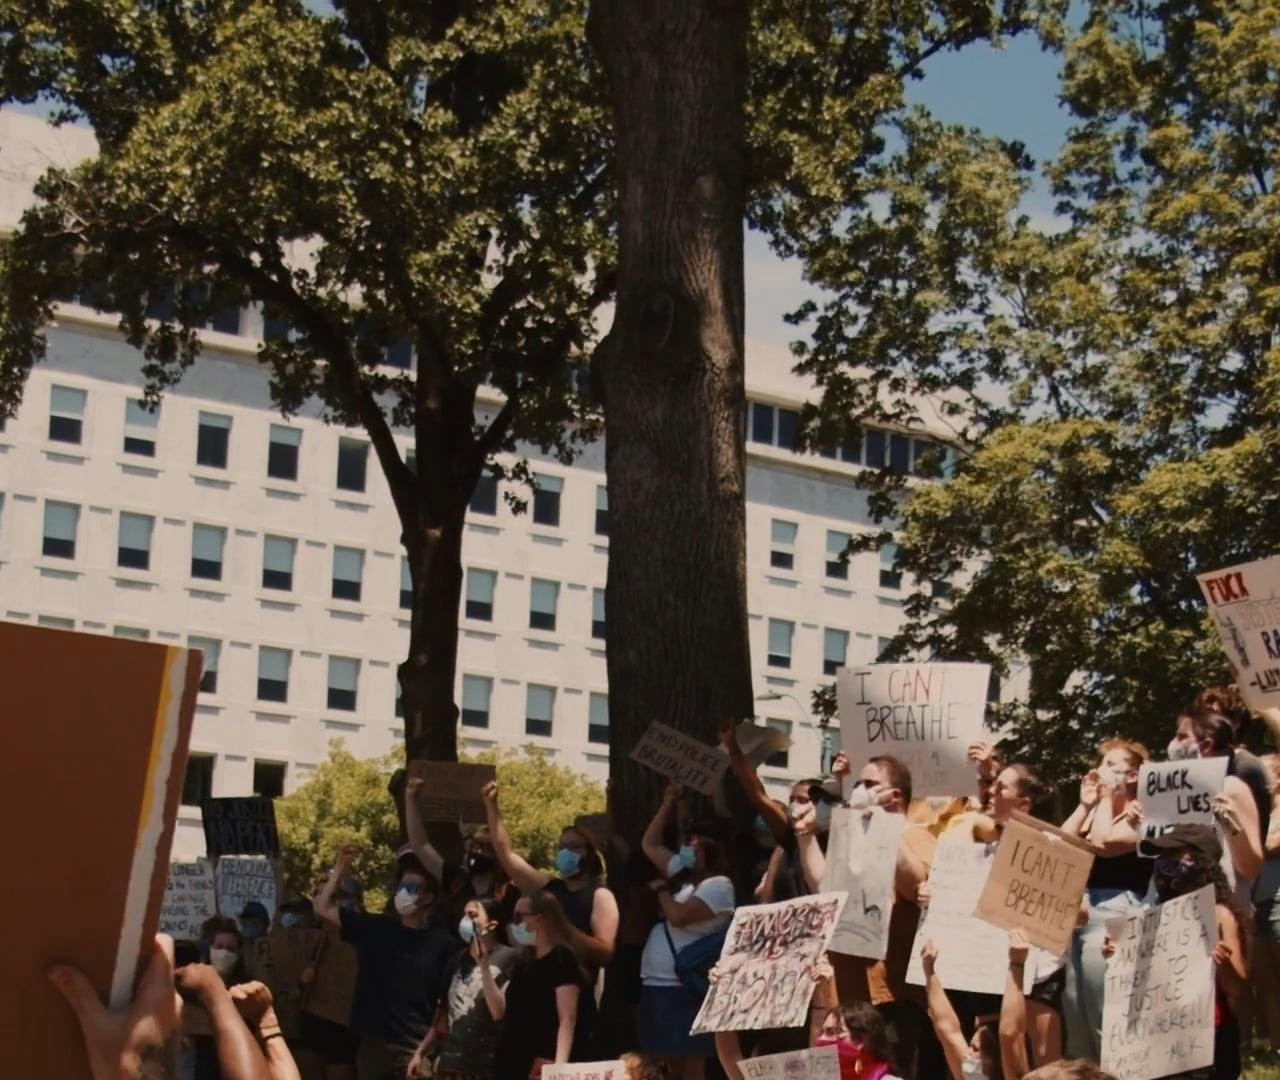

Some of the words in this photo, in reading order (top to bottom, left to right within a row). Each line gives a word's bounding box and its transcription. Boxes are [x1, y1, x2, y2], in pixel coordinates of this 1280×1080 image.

[1205, 572, 1250, 605] FUCK
[855, 672, 872, 705] I
[866, 703, 959, 744] BREATHE
[638, 744, 710, 786] BRUTALITY
[1147, 769, 1193, 797] BLACK
[1010, 841, 1021, 866] I
[1004, 878, 1076, 930] BREATHE
[1176, 928, 1191, 946] IS
[1167, 954, 1188, 976] TO
[1122, 977, 1185, 1018] JUSTICE
